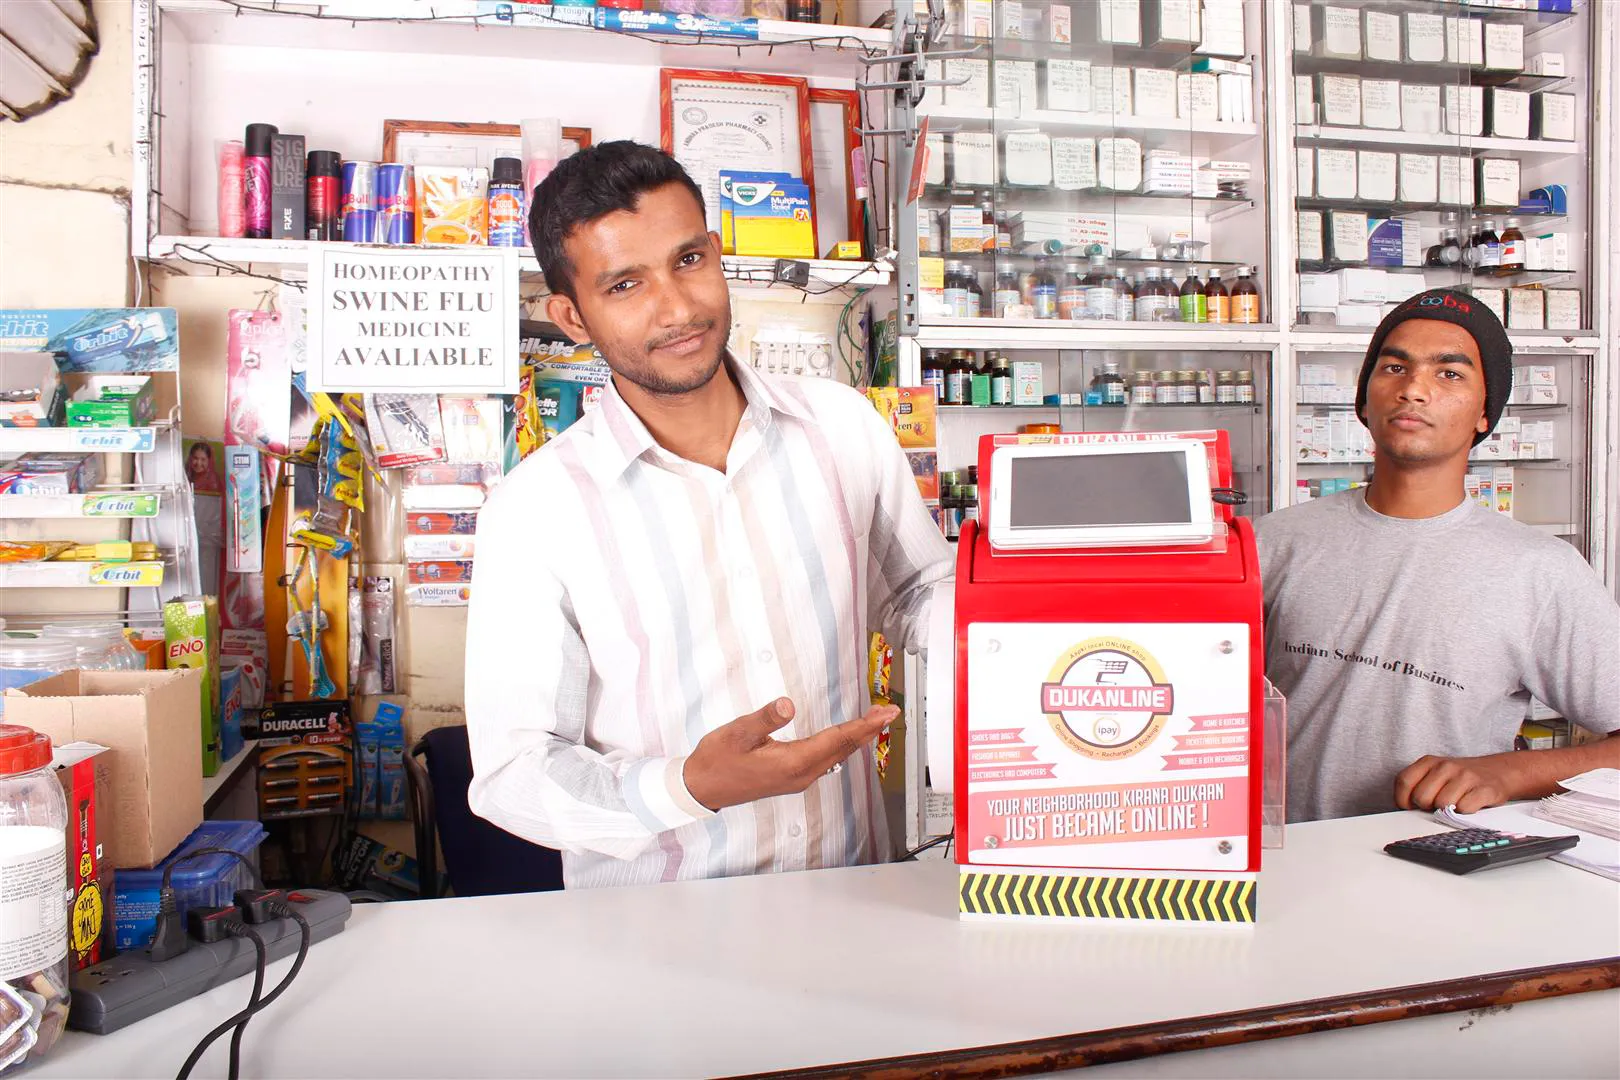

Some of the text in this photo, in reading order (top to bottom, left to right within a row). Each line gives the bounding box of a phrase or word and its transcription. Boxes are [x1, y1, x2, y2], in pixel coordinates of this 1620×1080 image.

[618, 10, 667, 25] Gillette
[684, 121, 774, 151] ANDHRA PRADESH PHARMACY COUNCIL
[348, 193, 369, 204] Bull
[284, 207, 293, 231] AXE
[333, 262, 495, 282] HOMEOPATHY
[333, 289, 494, 313] SWINE FLU
[0, 319, 49, 337] rbit
[358, 321, 471, 337] MEDICINE
[73, 327, 129, 352] Orbit
[519, 337, 575, 358] illette
[334, 346, 494, 367] AVALIABLE
[551, 363, 602, 373] COMFORTABLE
[80, 435, 123, 446] Orbit
[15, 483, 61, 495] Orbit
[96, 501, 135, 511] Orbit
[103, 570, 142, 581] Orbit
[422, 587, 457, 596] Voltaren
[169, 638, 205, 658] ENO
[1105, 641, 1132, 652] ONLINE
[1284, 640, 1466, 692] Indian School of Business
[1049, 687, 1166, 708] DUKANLINE
[262, 717, 327, 733] DURACELL
[1098, 726, 1118, 736] ipay
[1101, 747, 1133, 757] Recharges
[987, 783, 1225, 816] YOUR NEIGHBORHOOD KIRANA DUKAAN
[1003, 814, 1047, 843] JUST
[1052, 807, 1126, 839] BECAME
[1131, 803, 1197, 832] ONLINE
